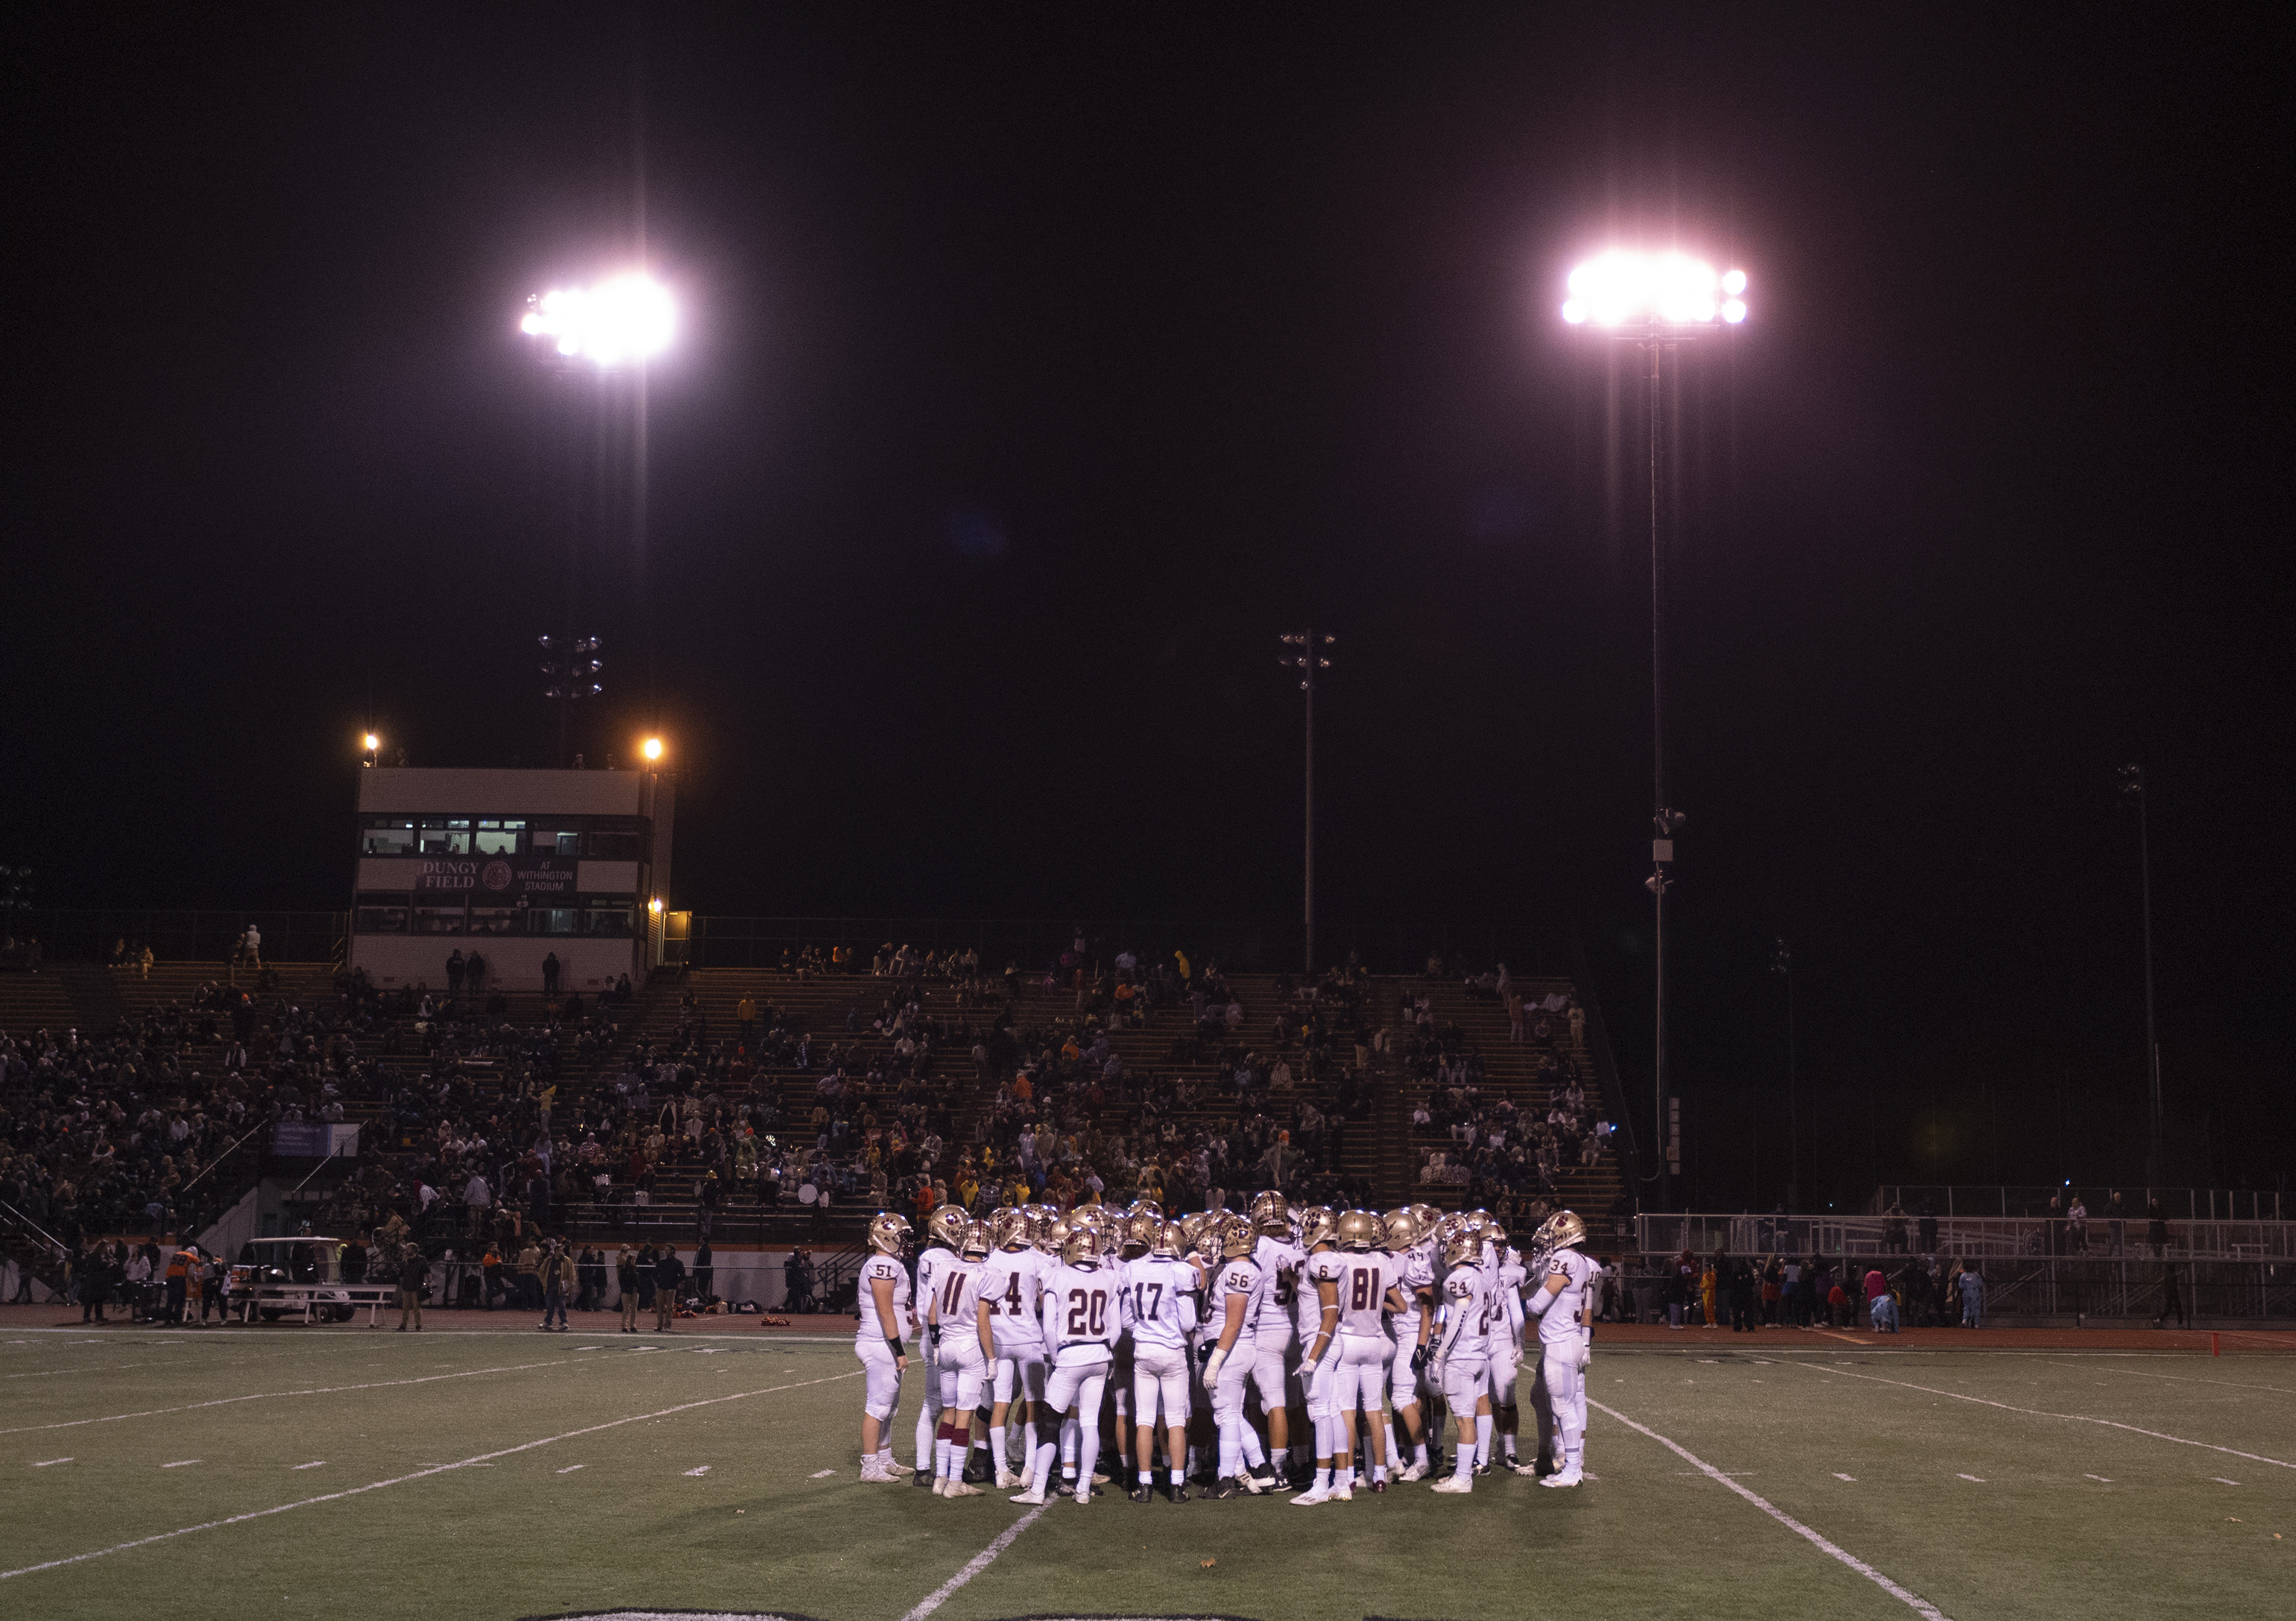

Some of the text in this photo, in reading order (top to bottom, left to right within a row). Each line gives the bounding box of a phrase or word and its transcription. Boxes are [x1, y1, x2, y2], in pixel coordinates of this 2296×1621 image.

[423, 862, 479, 875] DUNGY
[540, 861, 551, 870] AT
[426, 876, 475, 888] FIELD
[517, 871, 573, 881] WITHINGTON
[525, 881, 564, 891] STADIUM
[1407, 1252, 1424, 1261] 44
[876, 1265, 892, 1277] 51
[1319, 1265, 1328, 1278] 6
[1551, 1259, 1568, 1274] 34
[1230, 1272, 1249, 1288] 56
[1589, 1271, 1600, 1282] 10
[943, 1271, 967, 1315] 11
[1352, 1268, 1380, 1310] 81
[1449, 1281, 1468, 1294] 24
[1135, 1282, 1163, 1321] 17
[1067, 1288, 1108, 1335] 20
